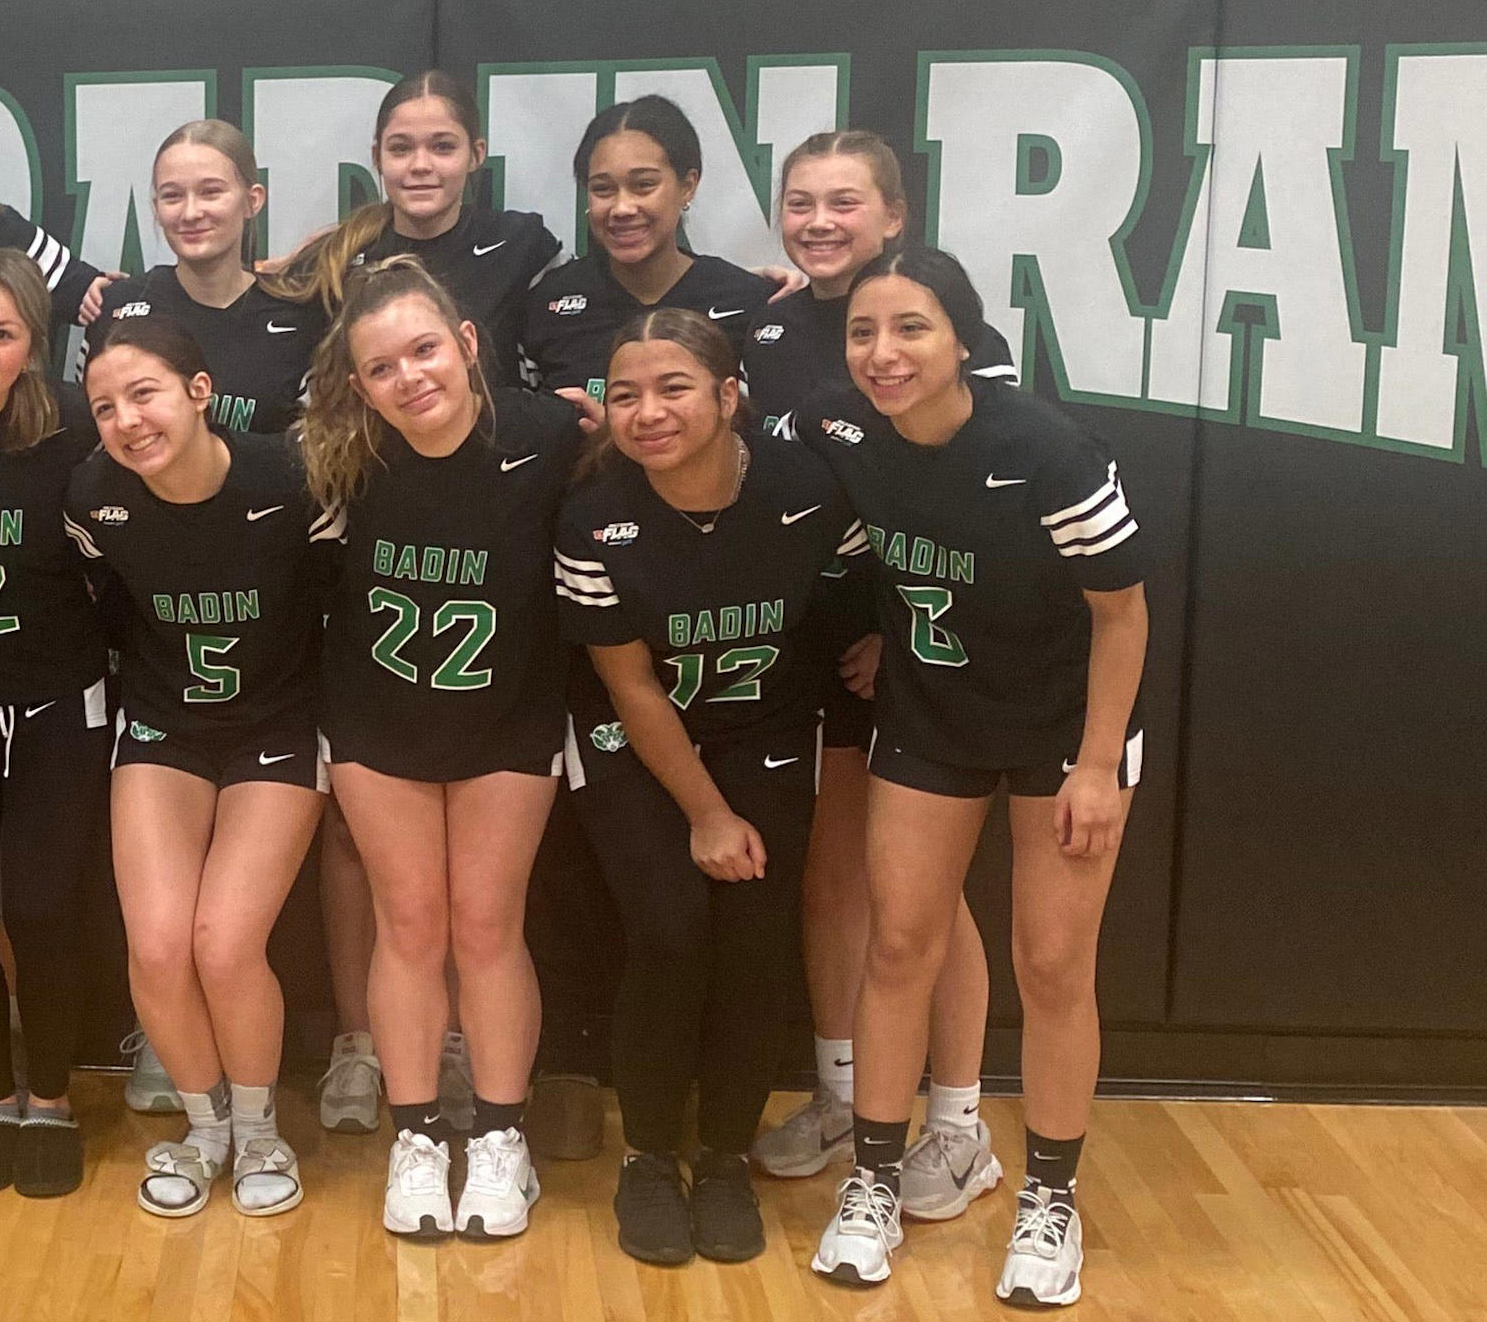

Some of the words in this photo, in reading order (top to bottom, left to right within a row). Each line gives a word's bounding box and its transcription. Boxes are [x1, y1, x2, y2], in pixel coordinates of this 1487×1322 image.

[118, 304, 152, 320] FLAG
[556, 298, 588, 314] FLAG
[755, 325, 785, 341] FLAG
[828, 419, 865, 445] FLAG
[98, 511, 129, 525] FLAG
[602, 524, 640, 544] FLAG
[374, 540, 489, 586] BADIN
[153, 589, 260, 625] BADIN
[369, 585, 498, 690] 22
[668, 599, 784, 648] BADIN
[184, 633, 241, 703] 5
[663, 644, 781, 710] 12
